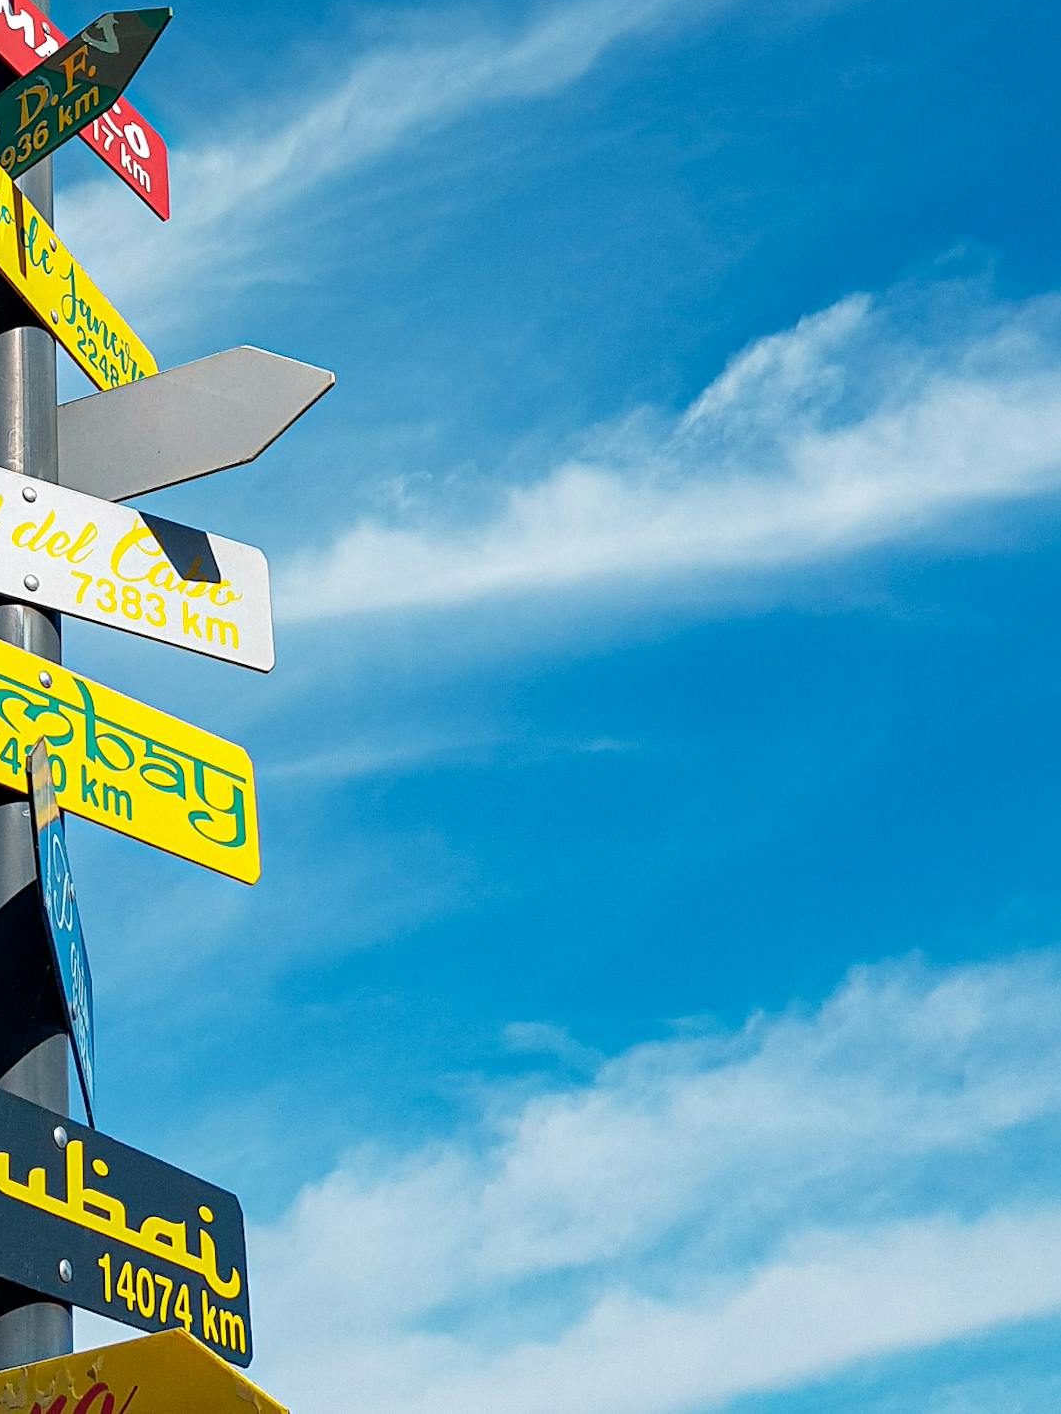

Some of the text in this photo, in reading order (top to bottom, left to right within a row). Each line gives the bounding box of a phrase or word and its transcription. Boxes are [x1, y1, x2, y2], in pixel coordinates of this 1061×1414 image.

[58, 86, 99, 133] km
[120, 142, 151, 194] km
[20, 216, 54, 275] de
[12, 509, 98, 564] del
[110, 518, 243, 606] Cabo
[70, 570, 239, 650] 7383 km
[81, 764, 133, 821] km
[98, 1252, 246, 1354] 14074 km
